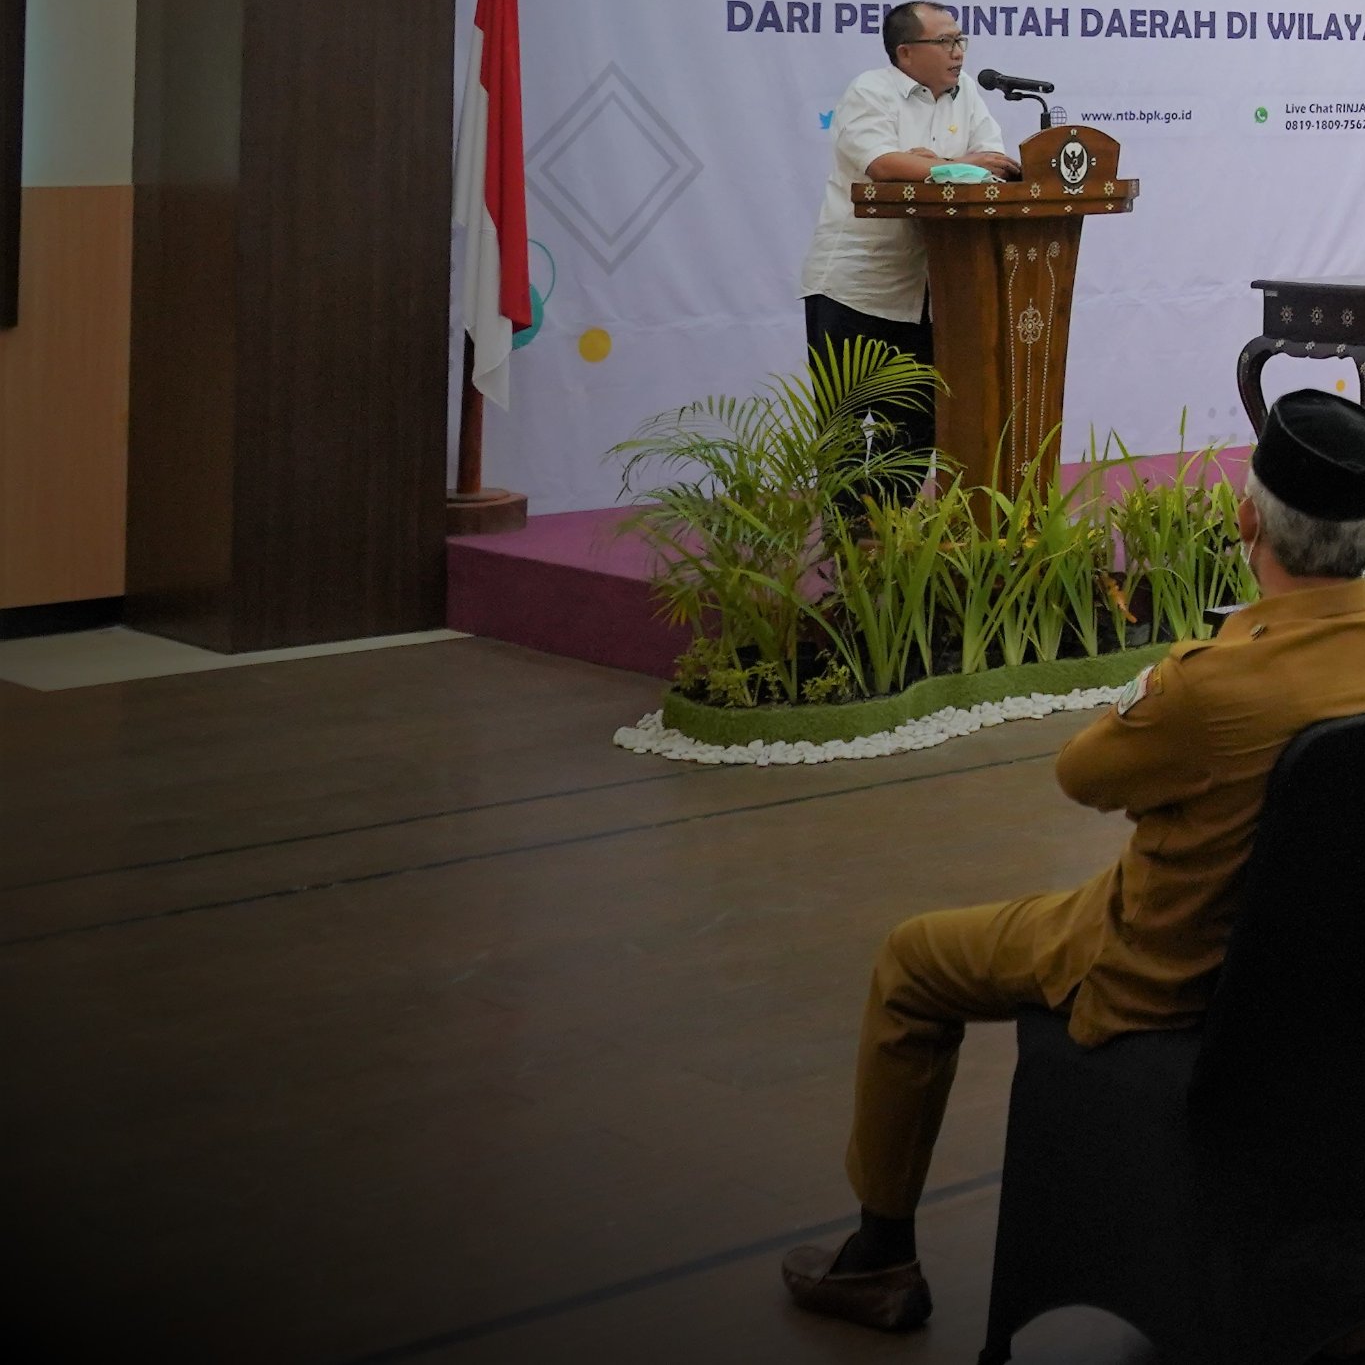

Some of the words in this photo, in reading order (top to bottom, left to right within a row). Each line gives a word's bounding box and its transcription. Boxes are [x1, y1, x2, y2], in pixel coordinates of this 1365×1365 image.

[727, 1, 821, 33] DARI
[835, 2, 1069, 37] PEINTAH
[1081, 8, 1216, 39] DAERAH
[1227, 12, 1257, 39] DI
[1286, 104, 1306, 113] Live
[1309, 104, 1333, 113] Chat
[1081, 110, 1191, 124] www.ntb.bpk.go.id
